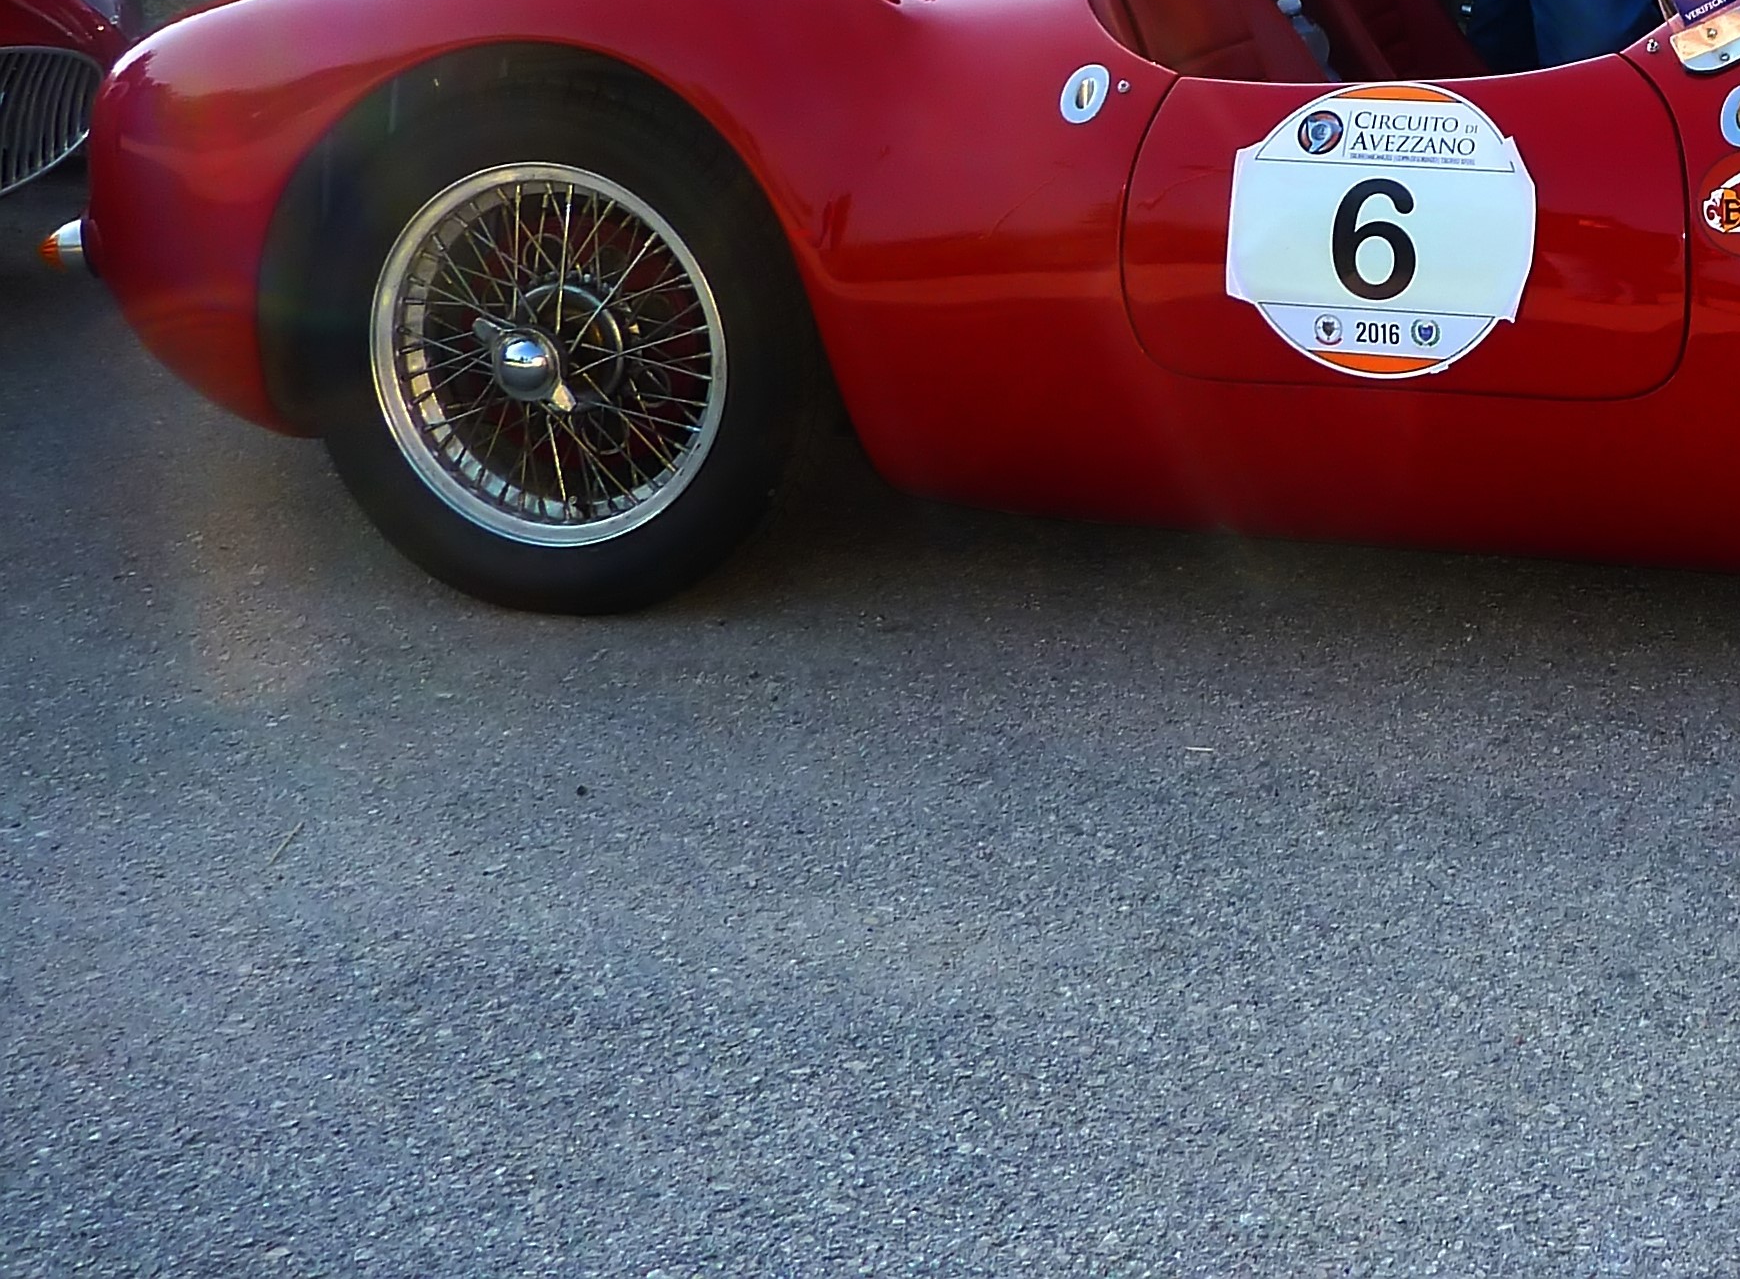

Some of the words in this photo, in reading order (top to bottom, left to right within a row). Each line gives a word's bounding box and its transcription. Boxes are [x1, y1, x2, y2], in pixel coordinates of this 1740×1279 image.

[1354, 110, 1459, 133] CIRCUITO
[1464, 123, 1478, 134] DI
[1349, 130, 1476, 156] AVEZZANO
[1331, 177, 1417, 301] 6
[1355, 321, 1401, 345] 2016
